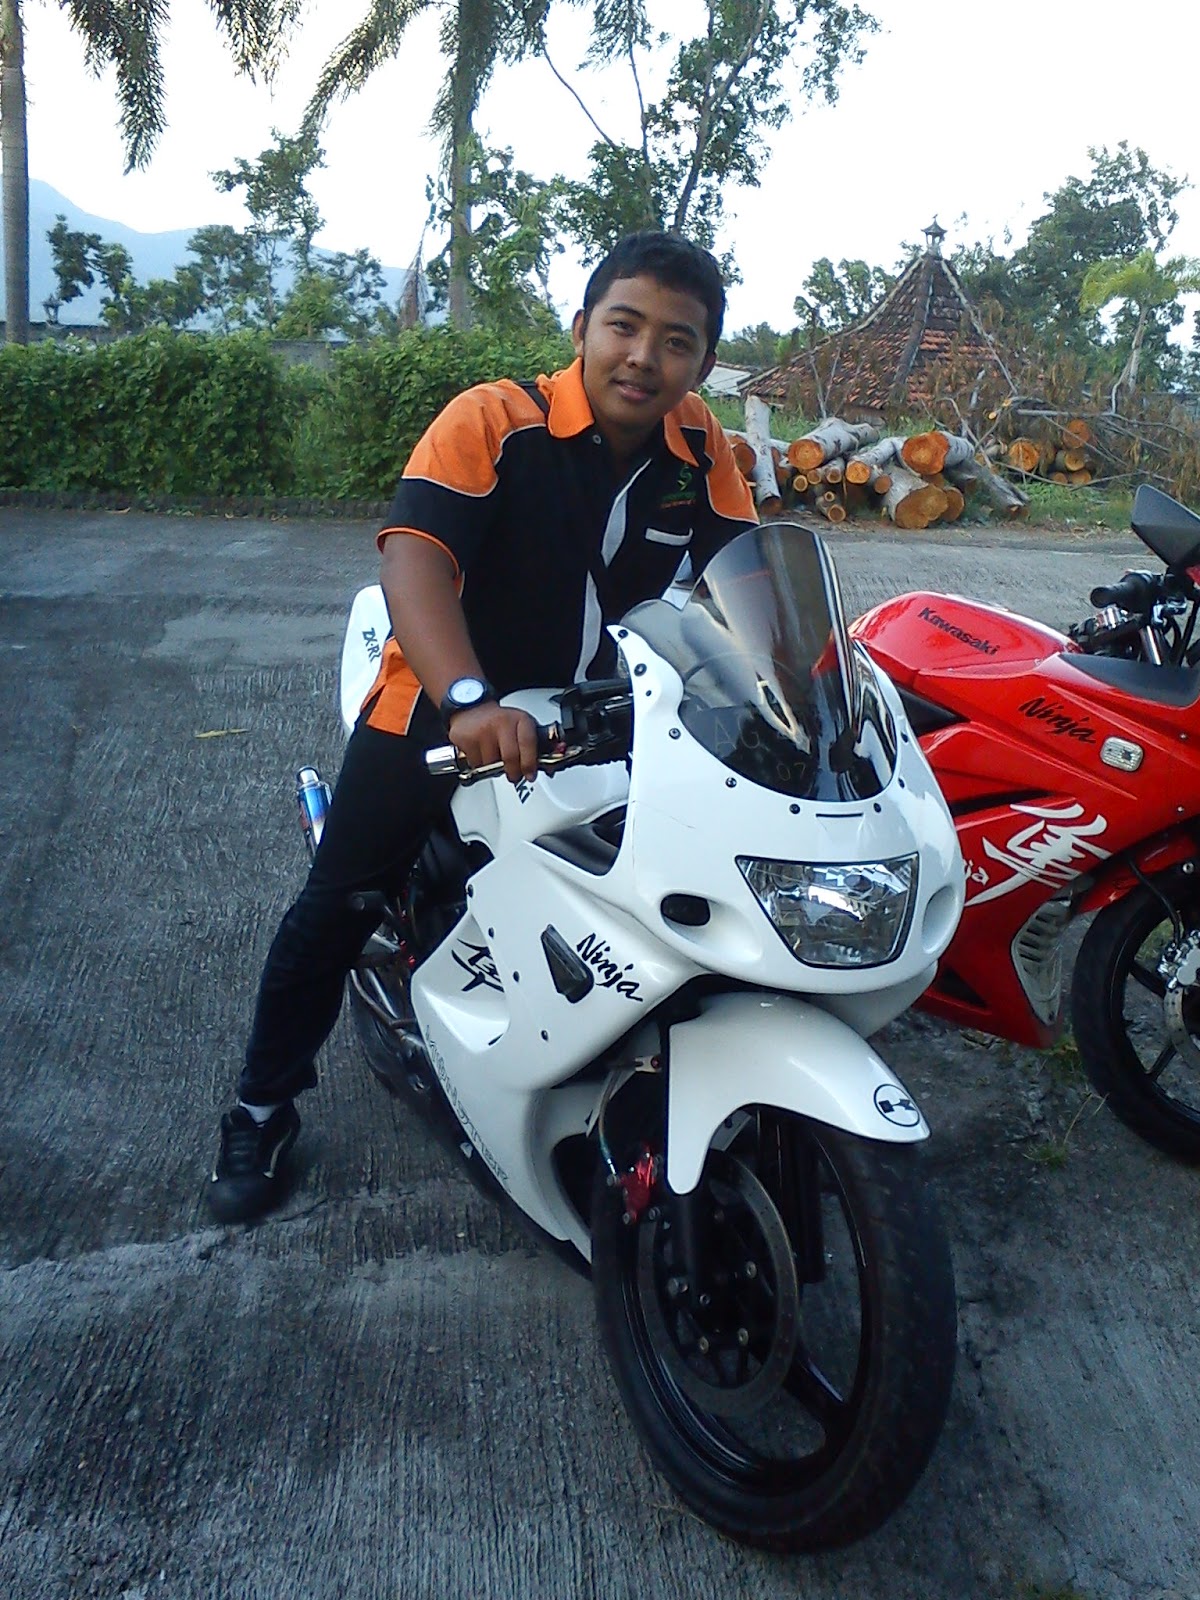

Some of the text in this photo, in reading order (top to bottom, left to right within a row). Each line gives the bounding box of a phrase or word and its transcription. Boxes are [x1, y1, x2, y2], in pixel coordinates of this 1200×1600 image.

[917, 606, 1001, 656] Kawasaki
[1018, 697, 1097, 744] Ninja
[576, 932, 644, 1003] Ninja
